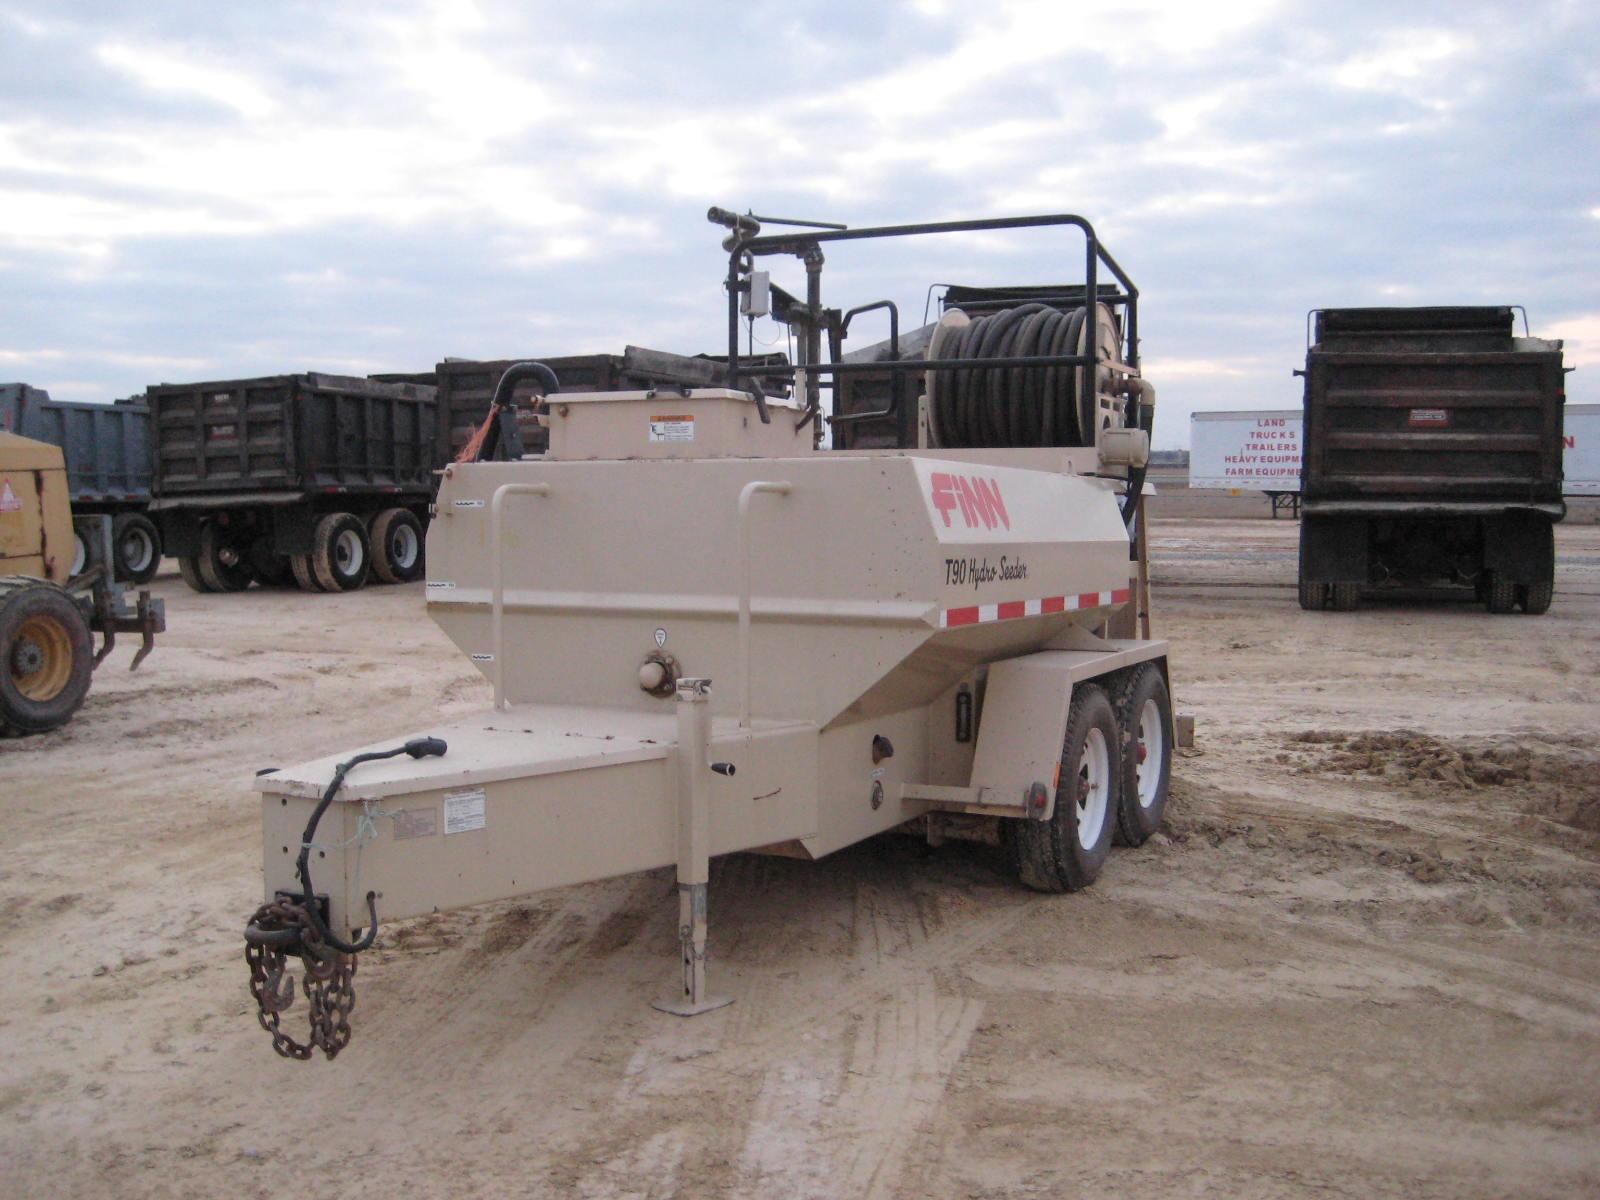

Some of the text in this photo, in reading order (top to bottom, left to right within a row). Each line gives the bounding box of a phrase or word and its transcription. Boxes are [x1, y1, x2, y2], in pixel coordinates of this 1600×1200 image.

[1257, 418, 1286, 427] LAND
[1249, 431, 1295, 439] TRUCKS
[1245, 443, 1297, 451] TRAILERS
[1224, 455, 1303, 463] HEAVY EQUIPM
[1225, 468, 1253, 476] FARM
[945, 555, 1027, 591] T90 Hydro Seeder
